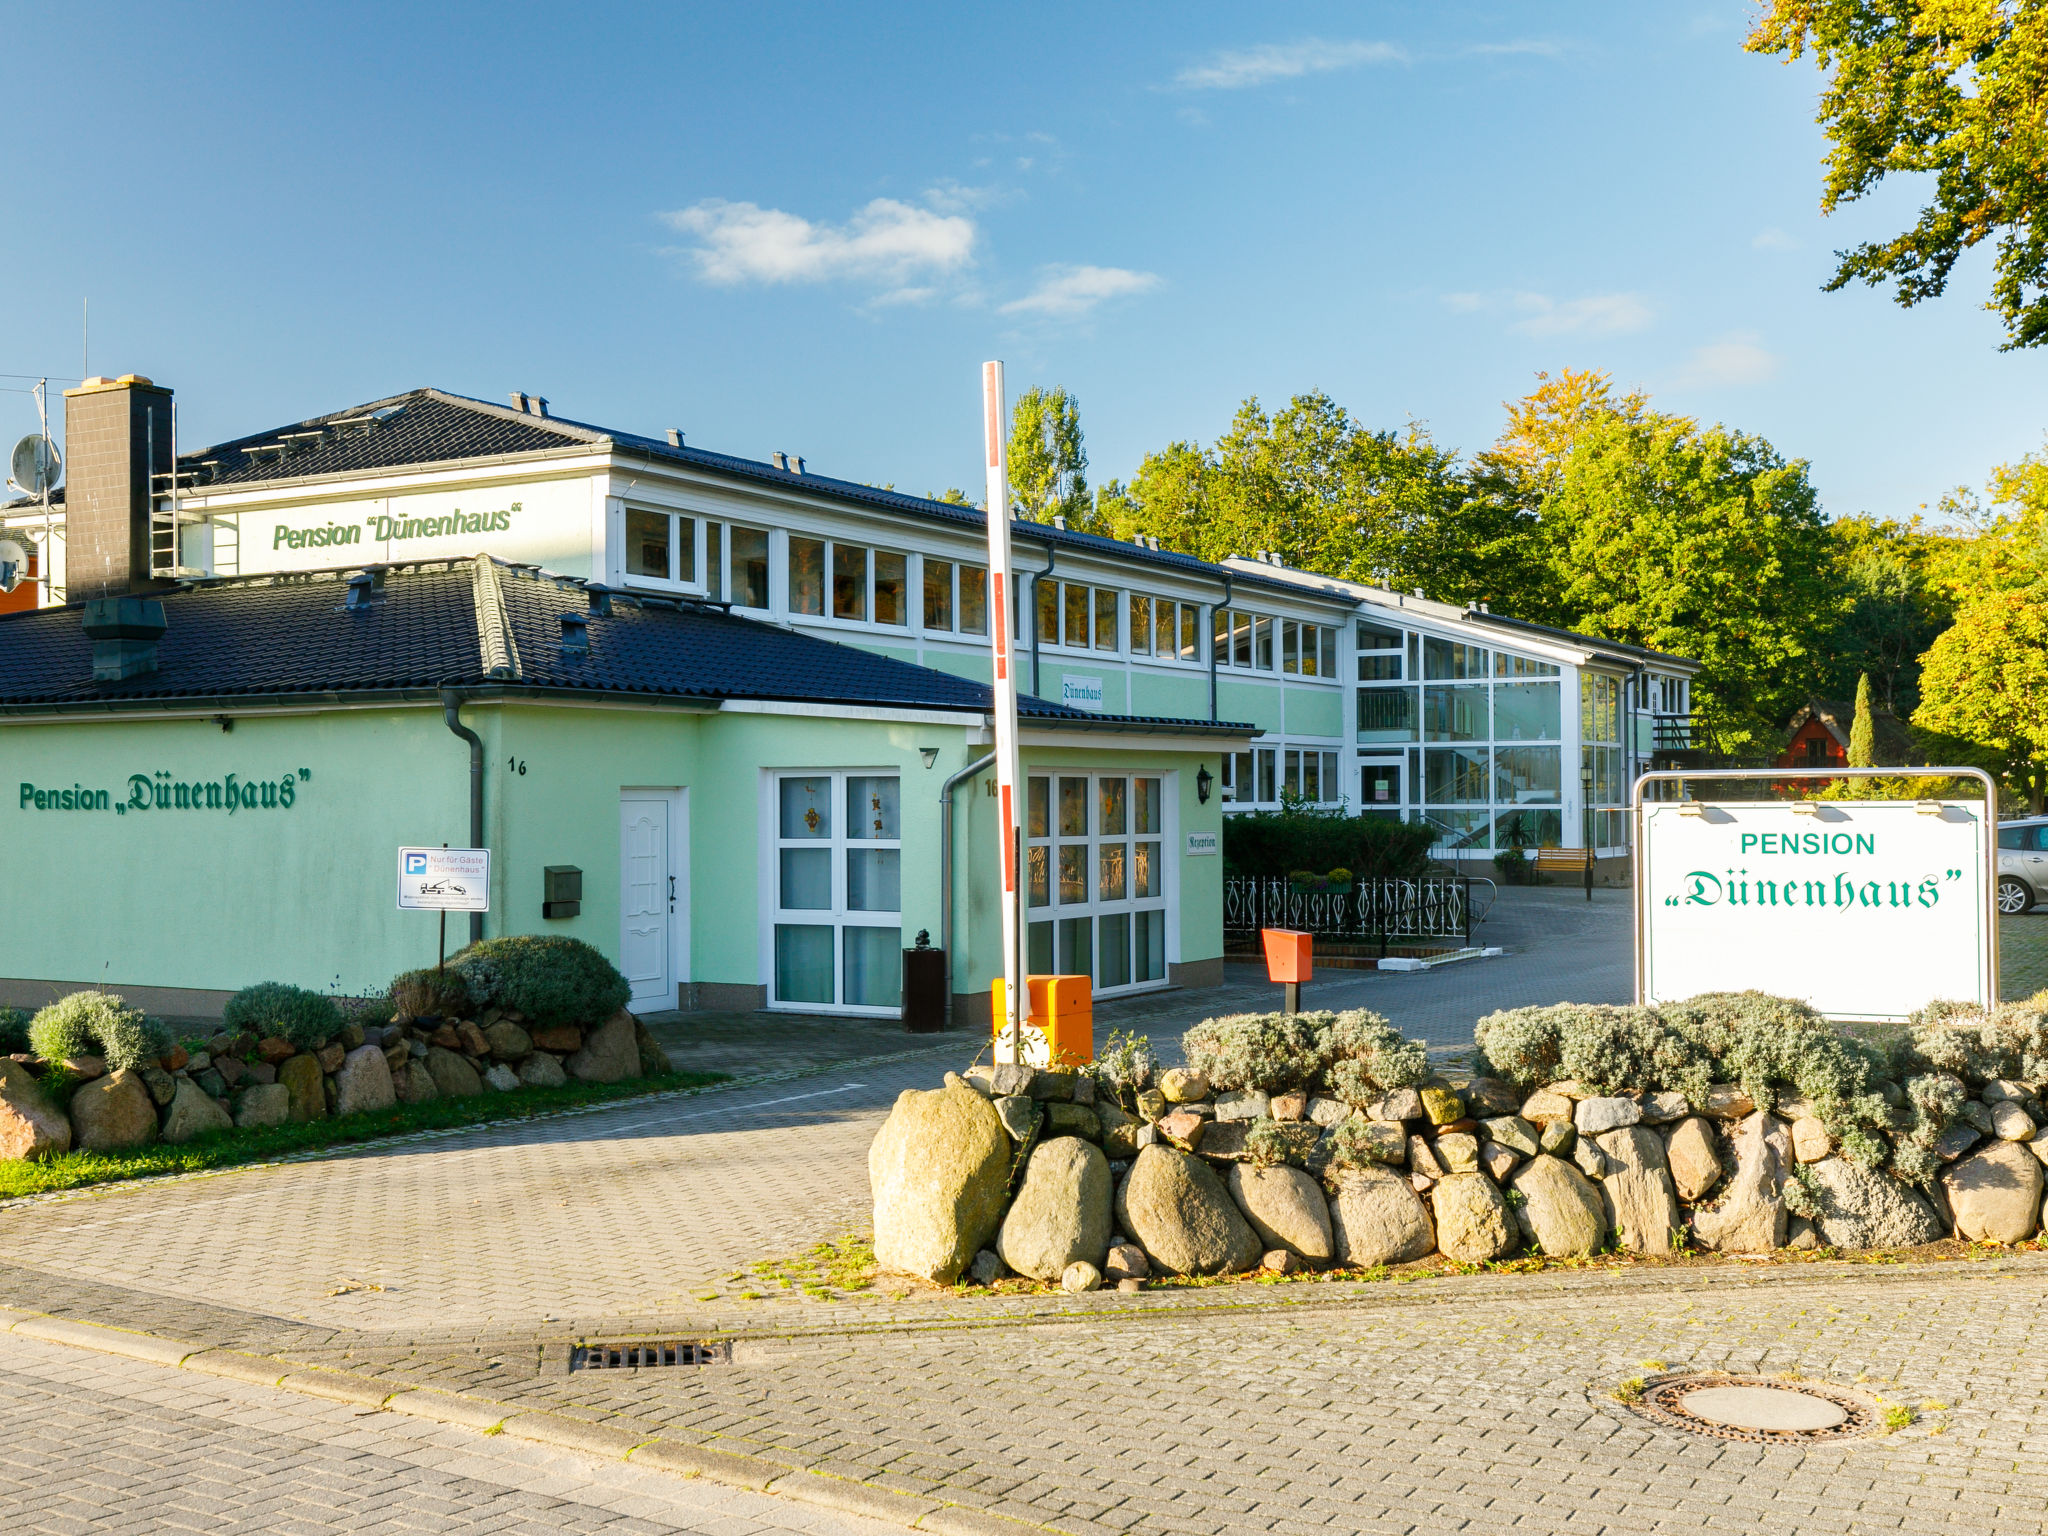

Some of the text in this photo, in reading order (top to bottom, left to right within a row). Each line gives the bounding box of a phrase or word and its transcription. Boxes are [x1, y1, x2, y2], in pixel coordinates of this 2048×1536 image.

[273, 521, 361, 550] Pension
[1063, 682, 1102, 701] Dünenhaus
[507, 755, 527, 776] 16
[19, 782, 109, 811] Pension
[1741, 833, 1875, 855] PENSION
